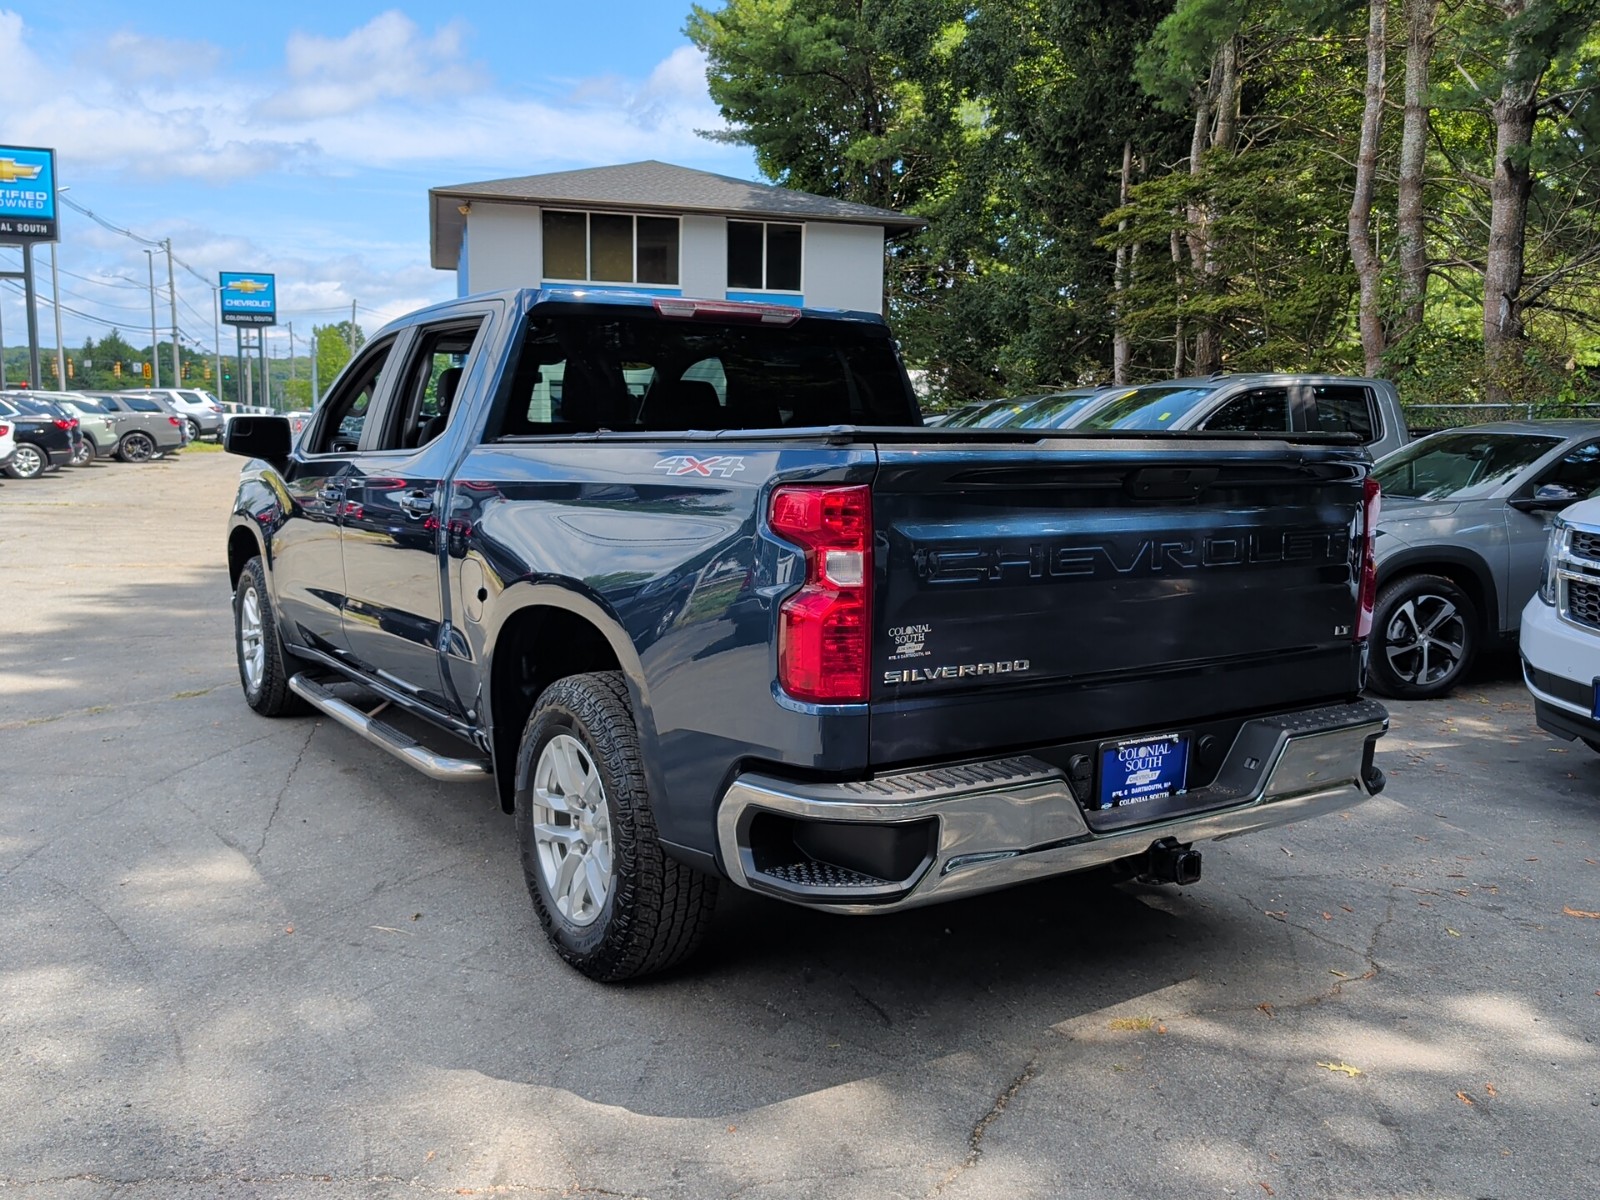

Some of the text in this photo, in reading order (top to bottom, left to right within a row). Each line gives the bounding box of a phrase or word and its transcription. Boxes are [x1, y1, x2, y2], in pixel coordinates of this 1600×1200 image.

[17, 223, 47, 233] SOUTH
[225, 299, 271, 307] CHEVROLET
[225, 314, 253, 322] COLONIAL
[926, 528, 1347, 584] CHEVROLET
[888, 624, 932, 637] COLONIAL
[1335, 625, 1351, 636] LT
[895, 633, 925, 645] SOUTH
[883, 659, 1030, 684] SILVERADO
[1118, 743, 1171, 761] COLONIAL
[1125, 756, 1162, 772] SOUTH
[1119, 791, 1169, 807] COLONIAL SOUTH
